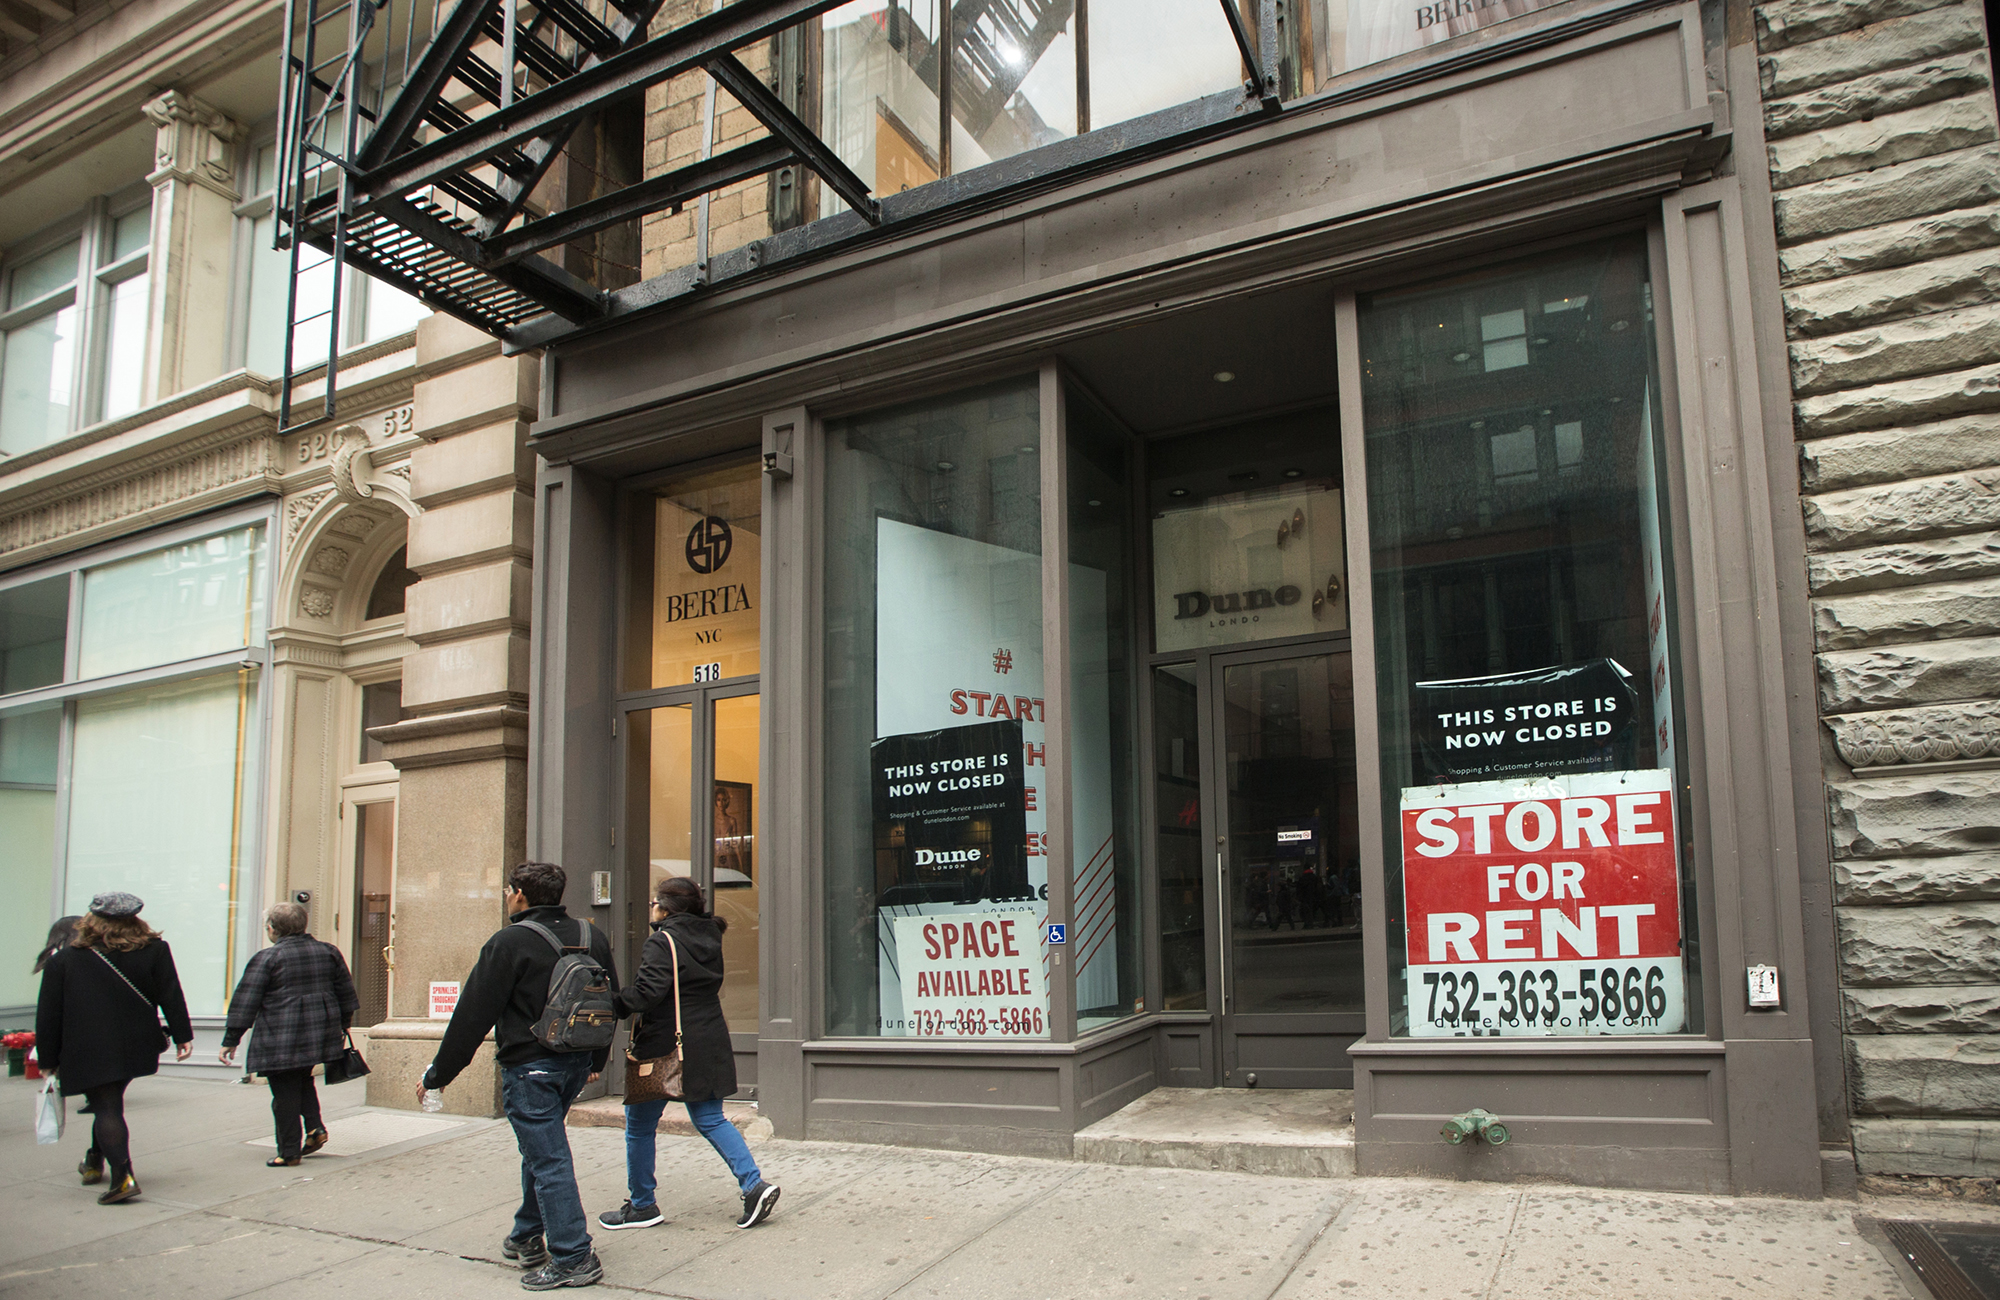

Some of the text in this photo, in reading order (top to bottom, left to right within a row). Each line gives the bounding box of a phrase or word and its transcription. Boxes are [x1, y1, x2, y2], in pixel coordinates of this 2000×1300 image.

[1414, 0, 1499, 31] BER
[665, 582, 753, 623] BERTA
[1209, 615, 1260, 628] LONDO
[695, 628, 722, 646] NYC
[694, 662, 720, 683] 518
[992, 648, 1013, 675] #
[1438, 697, 1617, 728] THIS STORE IS
[1445, 720, 1612, 750] NOW CLOSED
[884, 763, 923, 780] THIS
[930, 756, 985, 775] STORE
[990, 753, 1009, 768] IS
[1448, 766, 1482, 776] Shopping
[1493, 761, 1532, 771] Customer
[1534, 759, 1565, 768] Service
[1567, 755, 1602, 765] available
[889, 773, 1005, 798] NOW CLOSED
[922, 807, 949, 816] Customer
[950, 805, 971, 813] Service
[973, 802, 998, 811] available
[924, 815, 970, 824] dunelondon.com
[1414, 792, 1665, 858] STORE
[915, 848, 981, 866] Dune
[1487, 861, 1585, 903] FOR
[923, 920, 1019, 960] SPACE
[1427, 903, 1656, 962] RENT
[432, 986, 458, 994] SPRINKLERS
[917, 968, 1032, 998] AVAILABLE
[1423, 966, 1666, 1023] 732-363-5866
[875, 1016, 1030, 1030] dunelondon.com
[913, 1007, 1043, 1036] 732-363-5866
[1434, 1013, 1658, 1028] dunelondon.com
